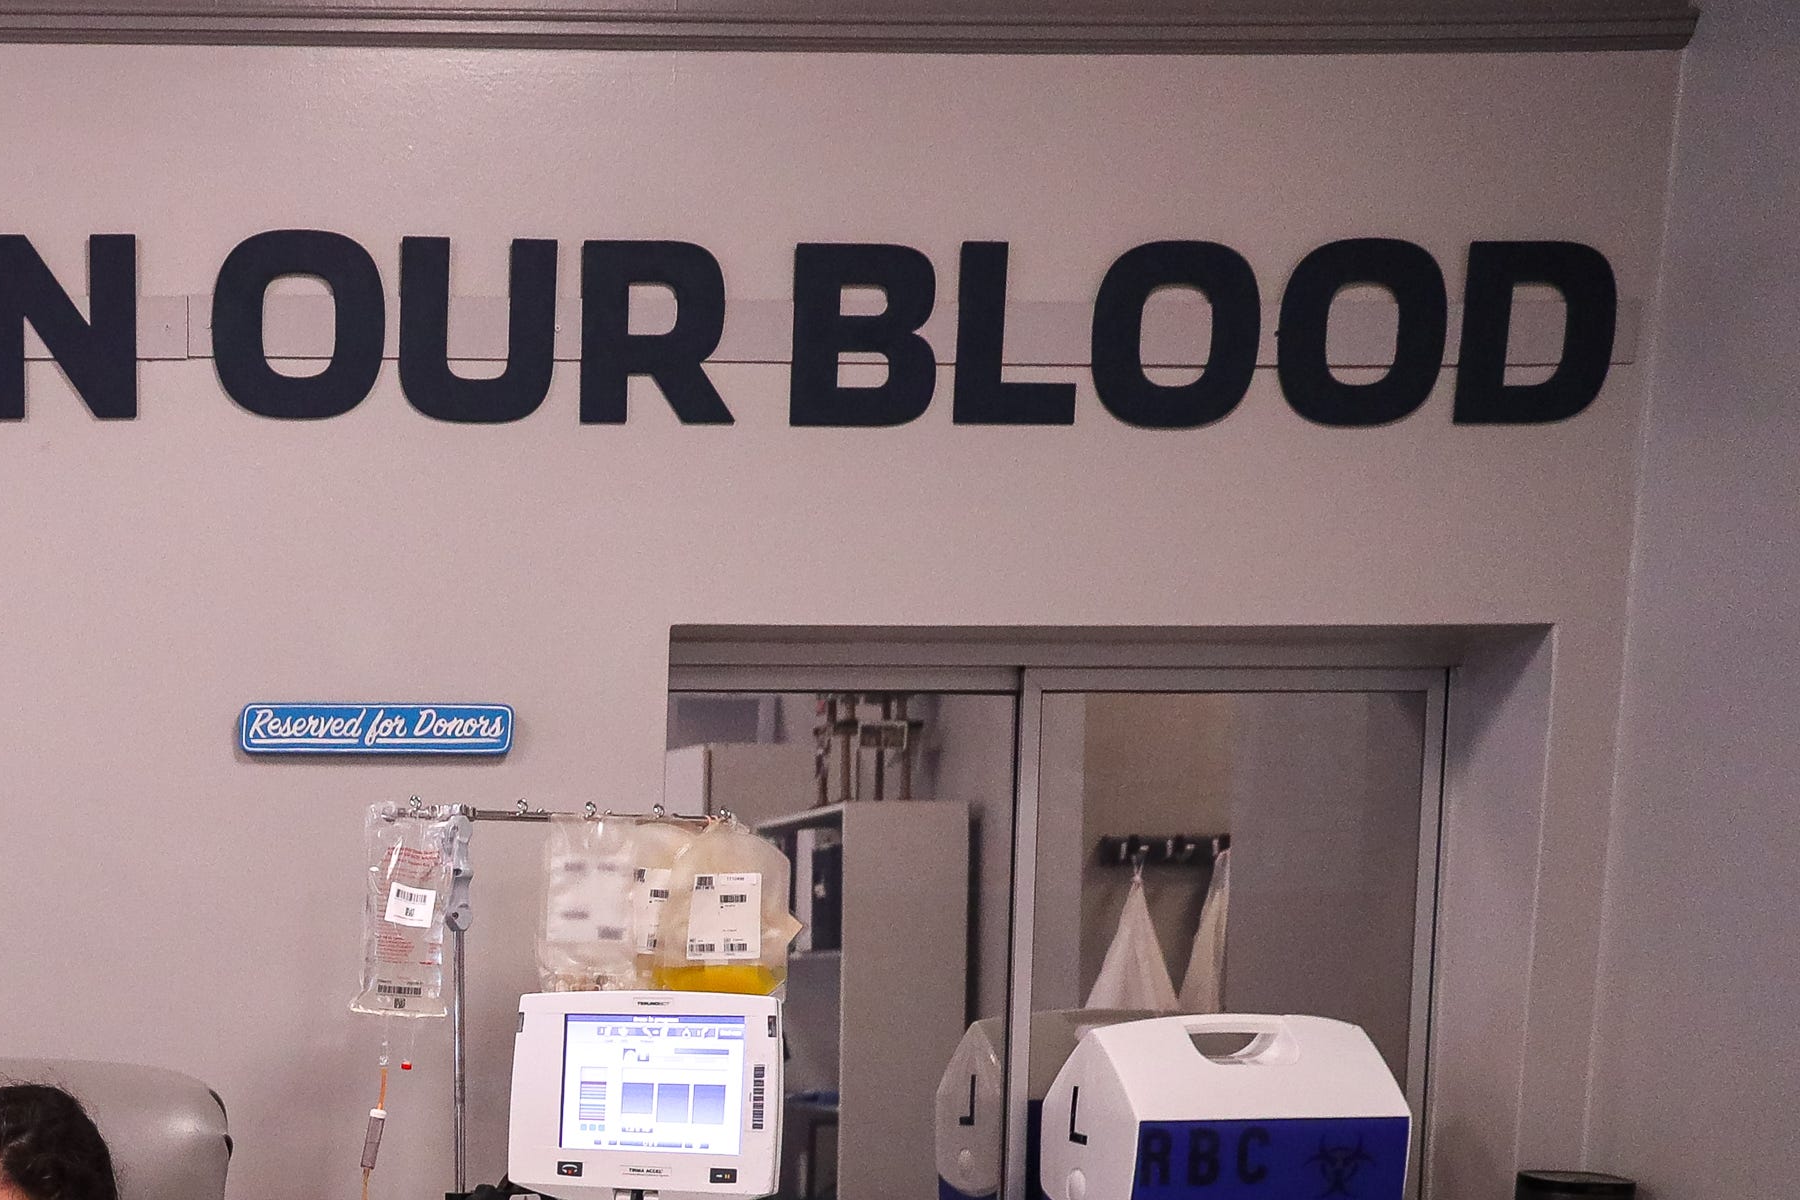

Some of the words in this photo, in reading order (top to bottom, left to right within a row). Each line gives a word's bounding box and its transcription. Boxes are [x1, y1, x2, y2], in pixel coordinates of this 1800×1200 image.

[211, 229, 735, 425] OUR
[789, 238, 1617, 430] BLOOD
[250, 708, 362, 738] Reserved
[364, 709, 407, 747] for
[412, 708, 504, 738] Donors
